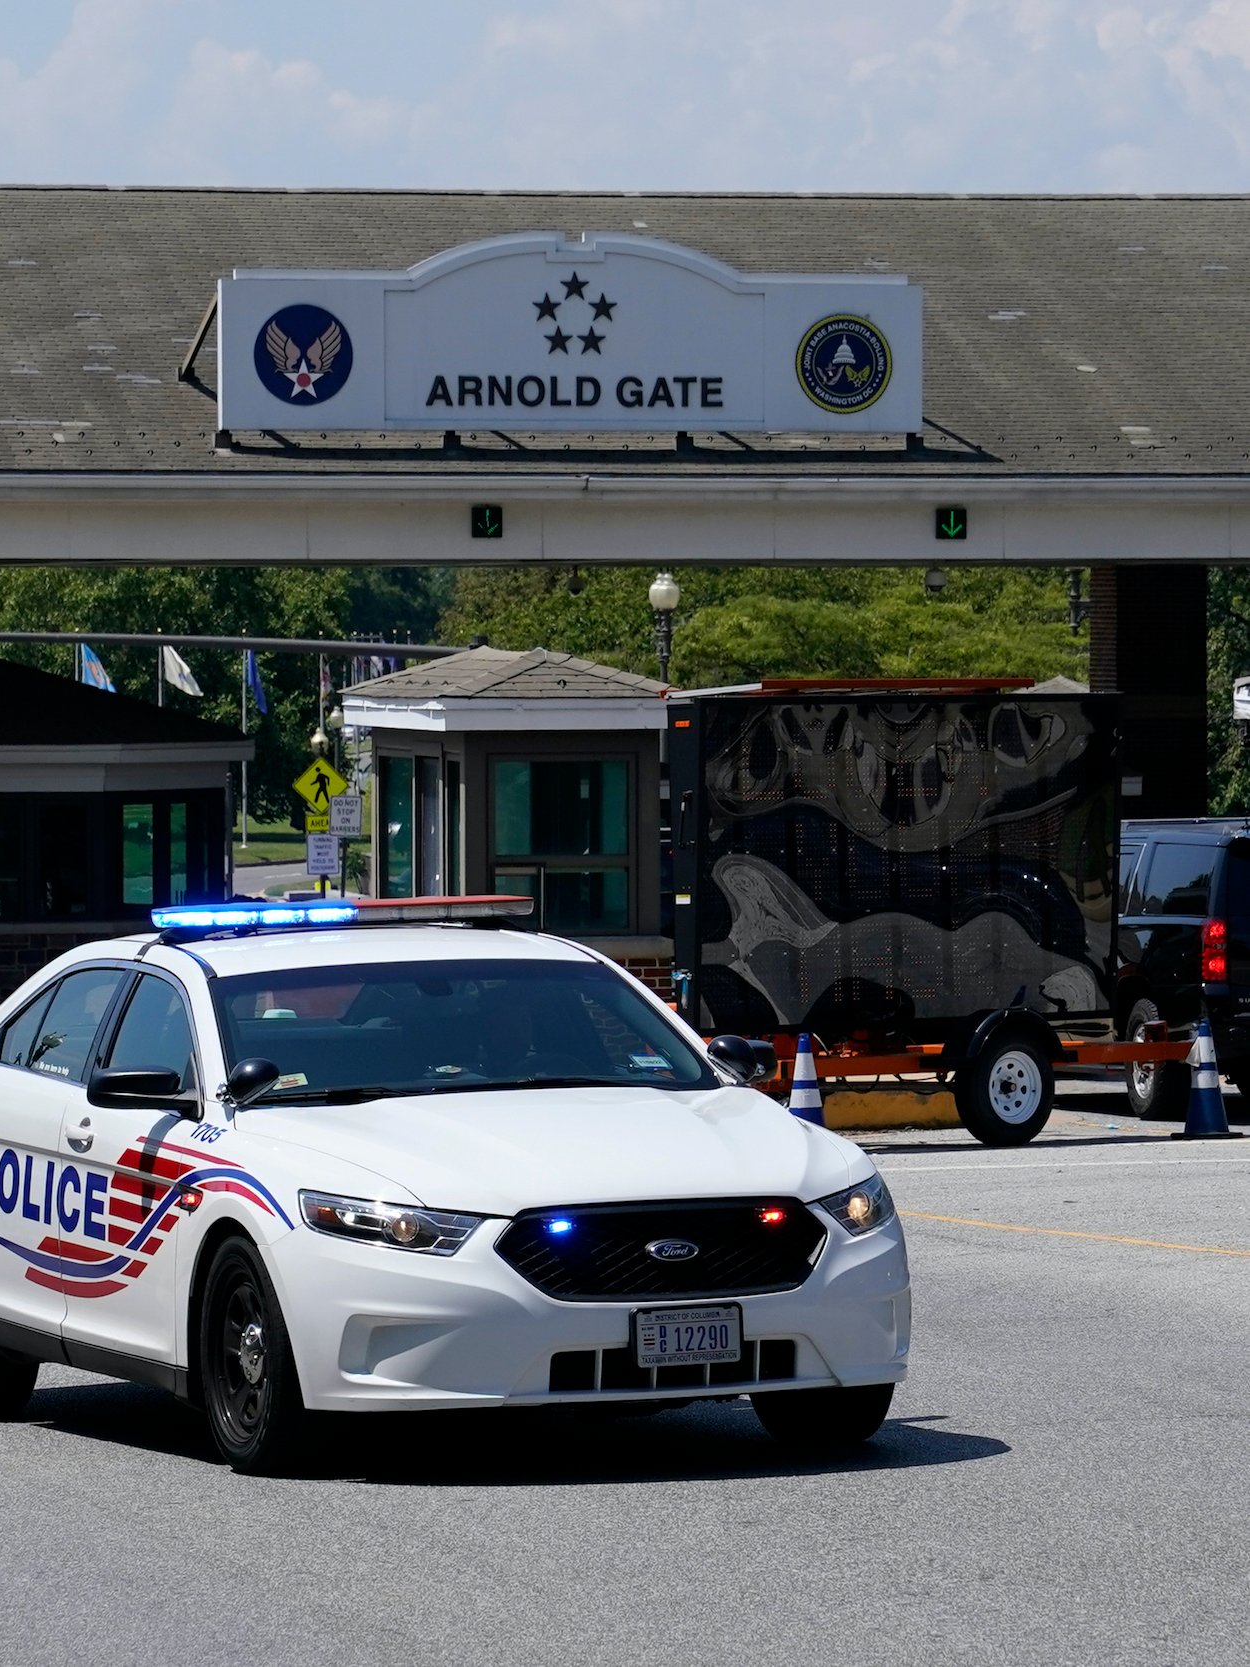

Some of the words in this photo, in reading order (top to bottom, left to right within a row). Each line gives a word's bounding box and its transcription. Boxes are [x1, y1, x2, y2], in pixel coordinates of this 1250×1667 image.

[804, 345, 813, 370] JOINT
[810, 329, 828, 347] BASE
[426, 375, 601, 407] ARNOLD
[616, 376, 723, 408] GATE
[815, 386, 863, 405] WASHINGTON
[863, 387, 874, 398] DC
[190, 1122, 228, 1143] 1705
[662, 1244, 689, 1256] Ford
[674, 1324, 729, 1352] 12290
